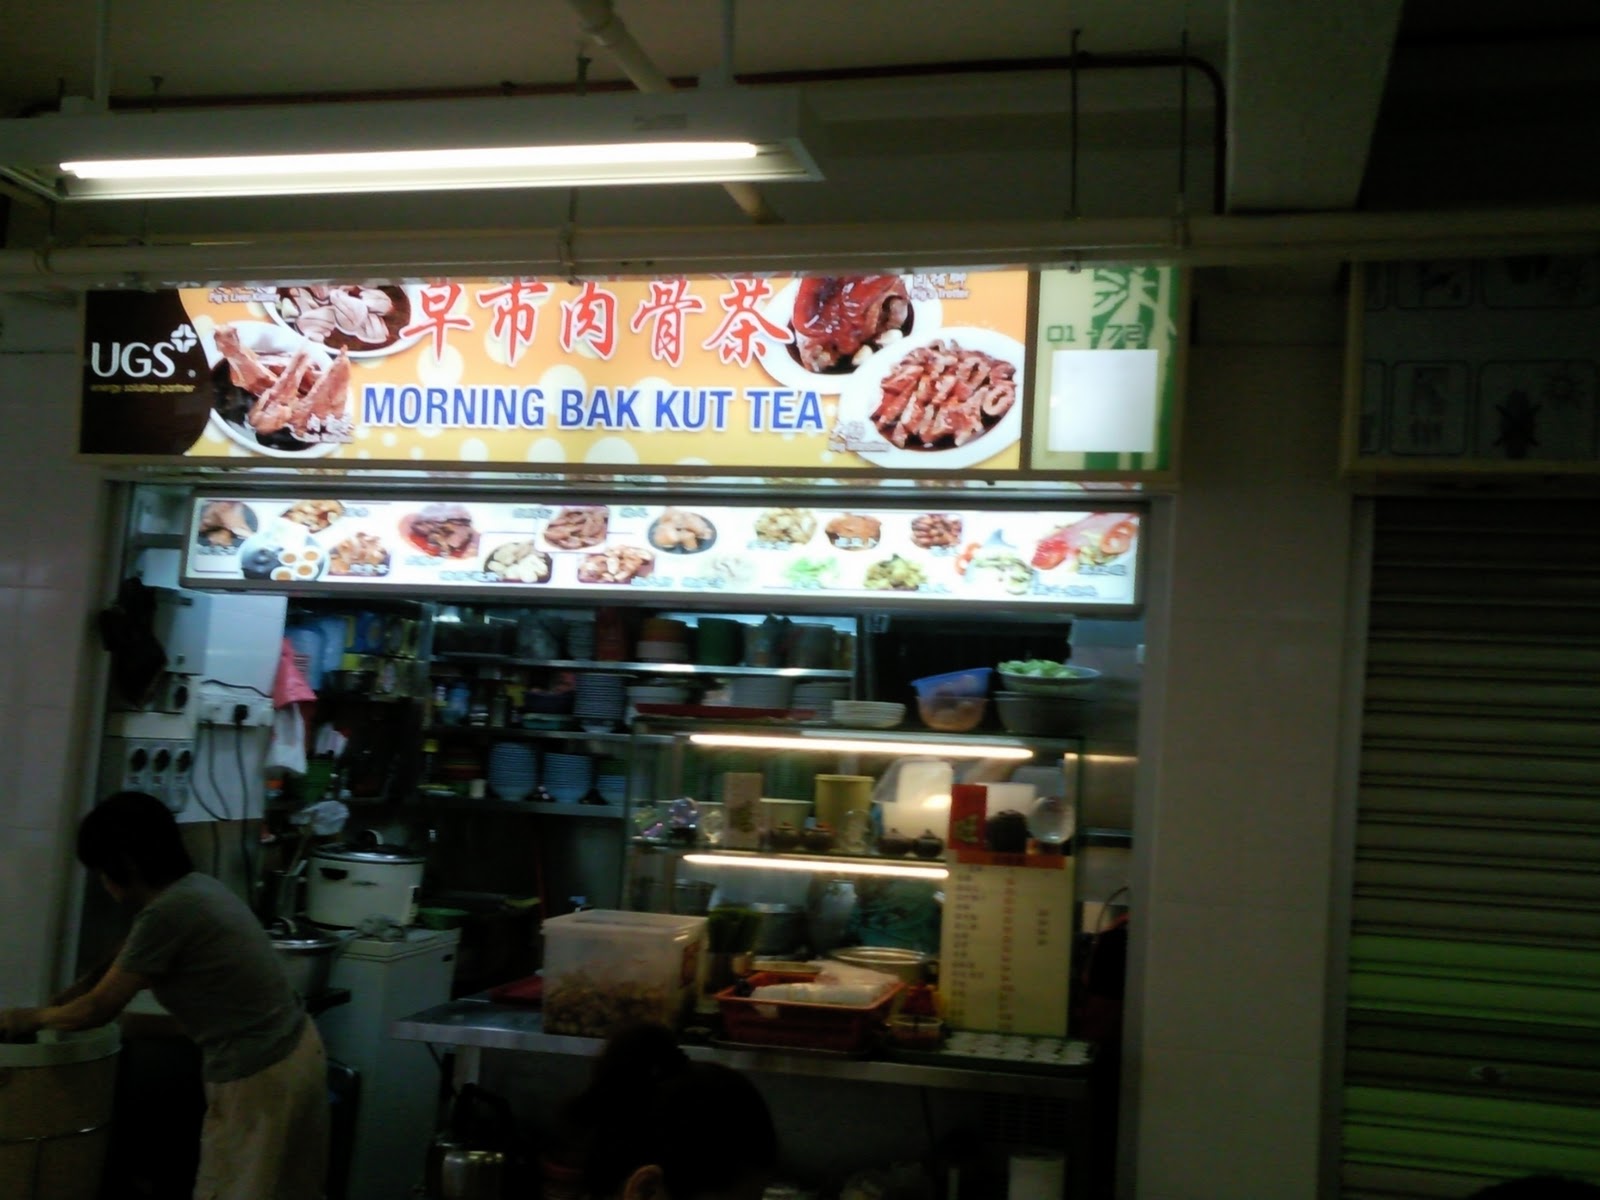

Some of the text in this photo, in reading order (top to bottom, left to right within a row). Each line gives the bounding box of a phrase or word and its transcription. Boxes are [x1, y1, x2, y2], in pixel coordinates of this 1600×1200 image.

[403, 279, 791, 363] 早市肉骨茶
[91, 342, 176, 378] UGS
[364, 387, 824, 430] MORNING BAK KUT TEA
